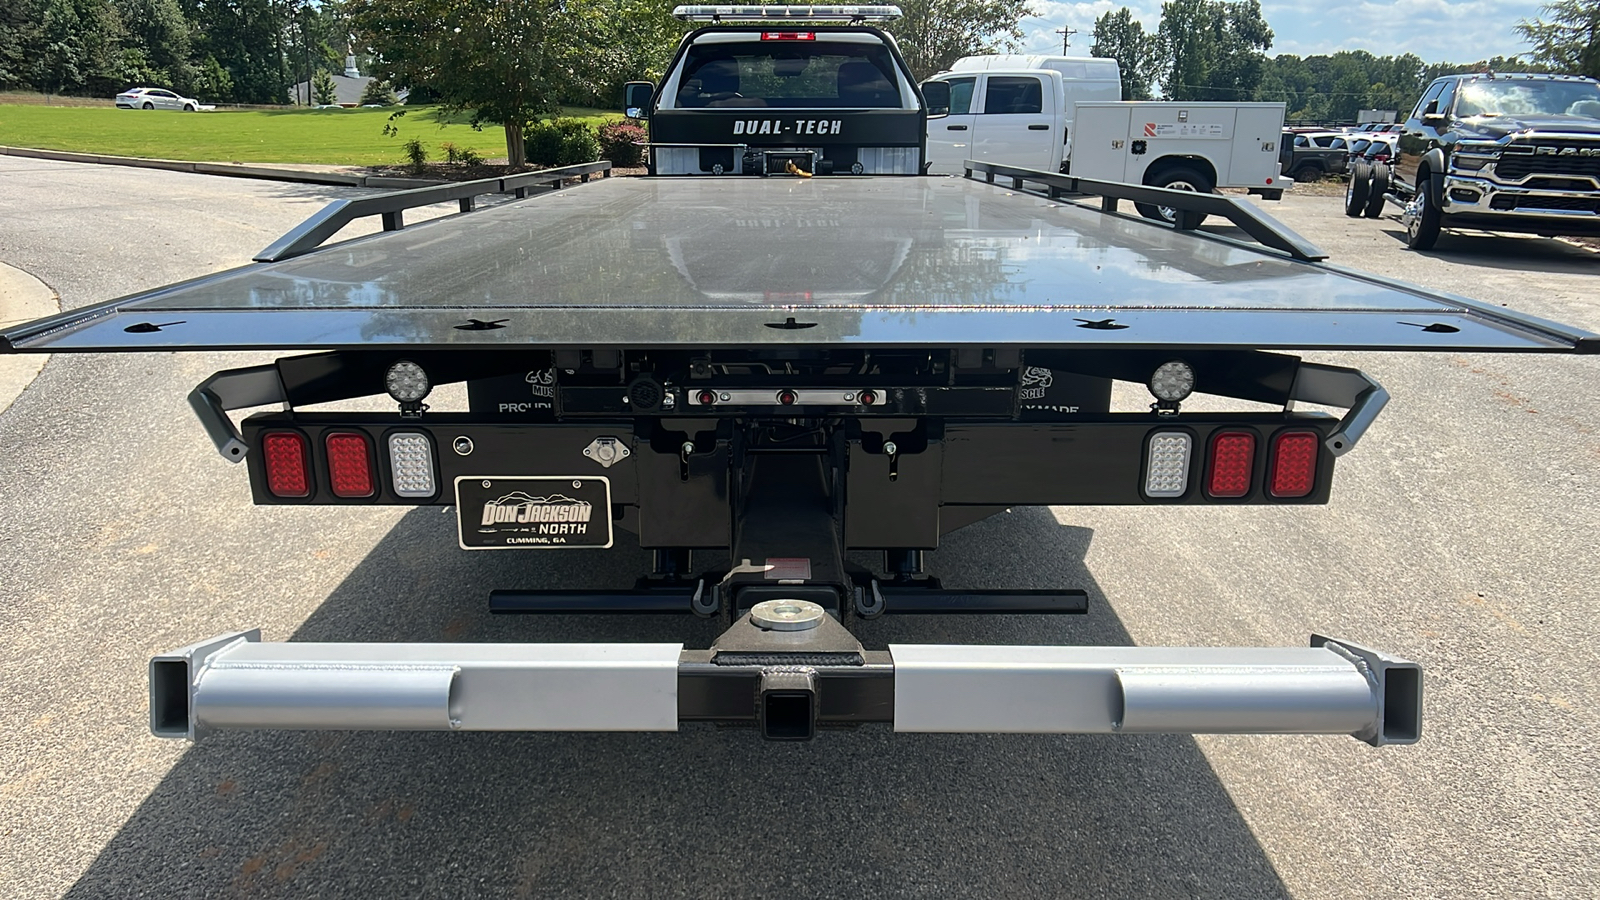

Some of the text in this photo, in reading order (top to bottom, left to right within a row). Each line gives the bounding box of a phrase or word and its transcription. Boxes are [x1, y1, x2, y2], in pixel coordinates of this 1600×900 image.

[1536, 146, 1600, 156] RAM
[532, 384, 554, 397] MUS
[1021, 388, 1045, 399] SCLE
[481, 504, 592, 525] DON JACKSON
[539, 524, 587, 534] NORTH
